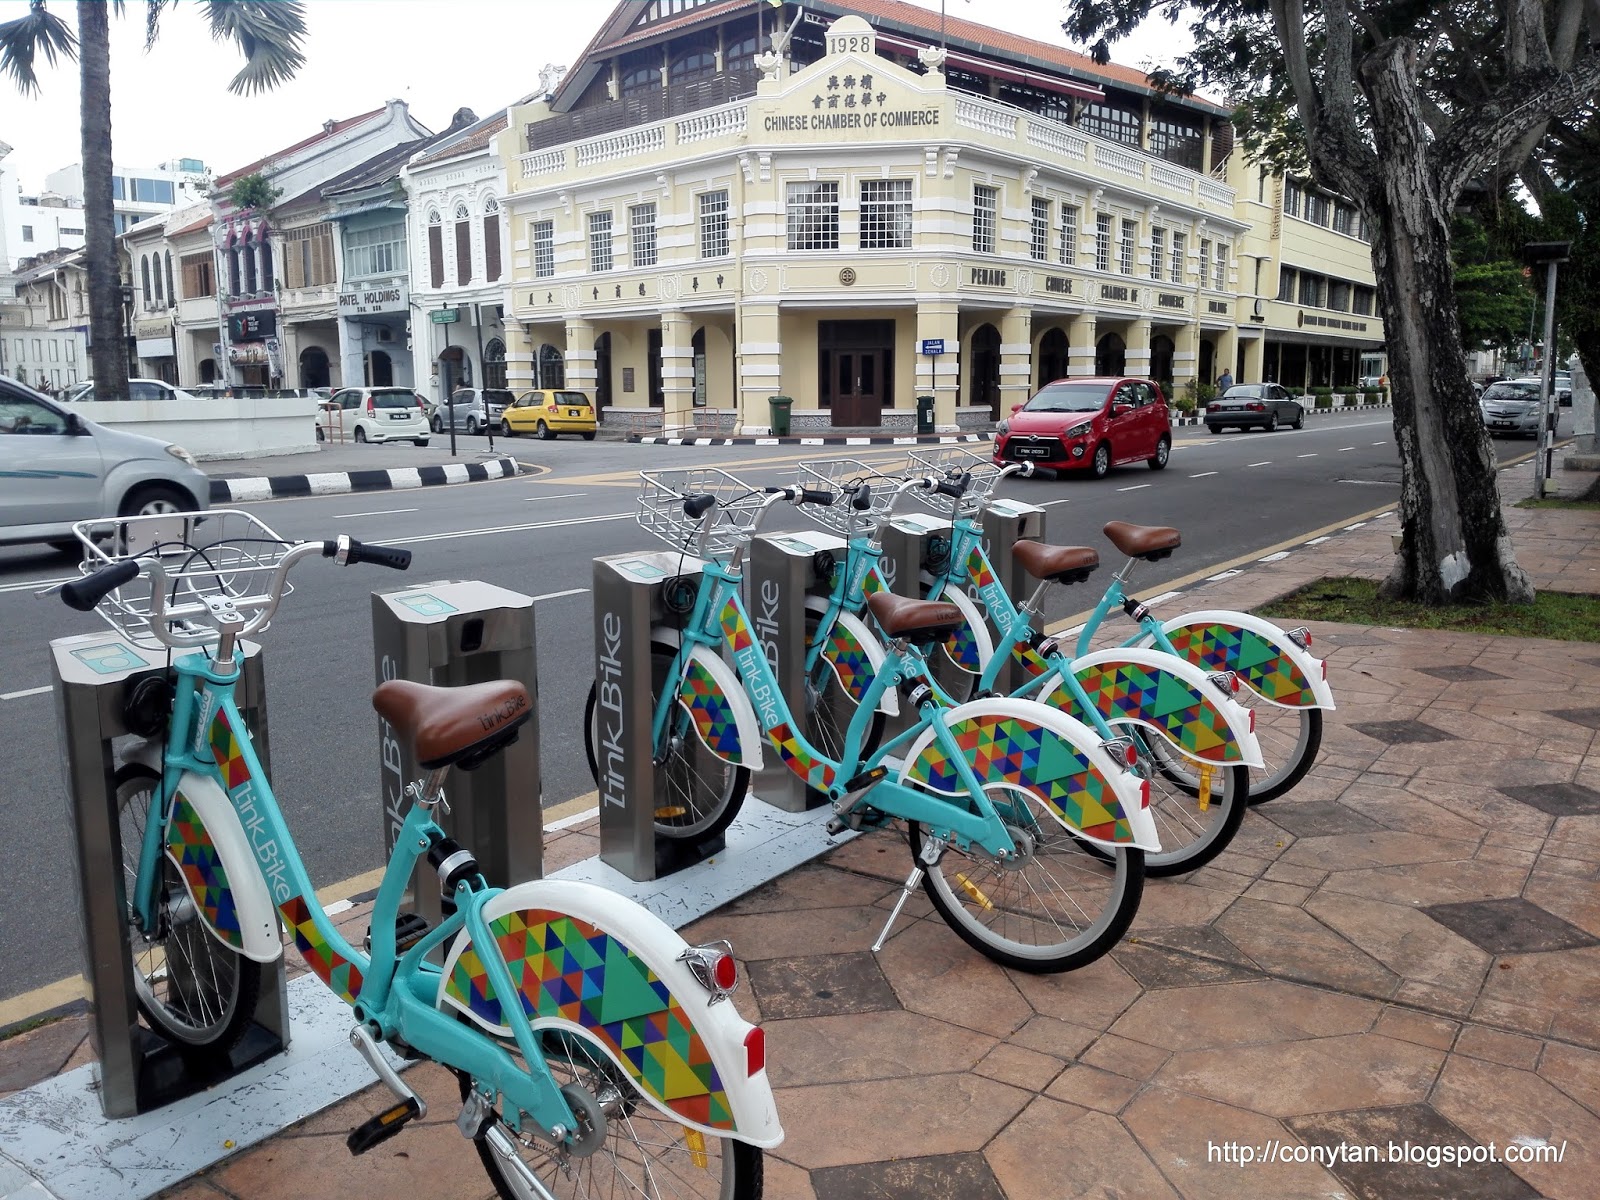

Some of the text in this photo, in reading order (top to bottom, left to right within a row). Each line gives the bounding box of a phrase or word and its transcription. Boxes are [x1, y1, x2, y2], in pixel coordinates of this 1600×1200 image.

[830, 36, 870, 54] 1928
[764, 110, 939, 131] CHINESE CHAMBER OF COMMERCE
[971, 267, 1006, 287] PENANG
[1045, 276, 1073, 294] CHINESE
[339, 288, 401, 306] PATEL HOLDINGS
